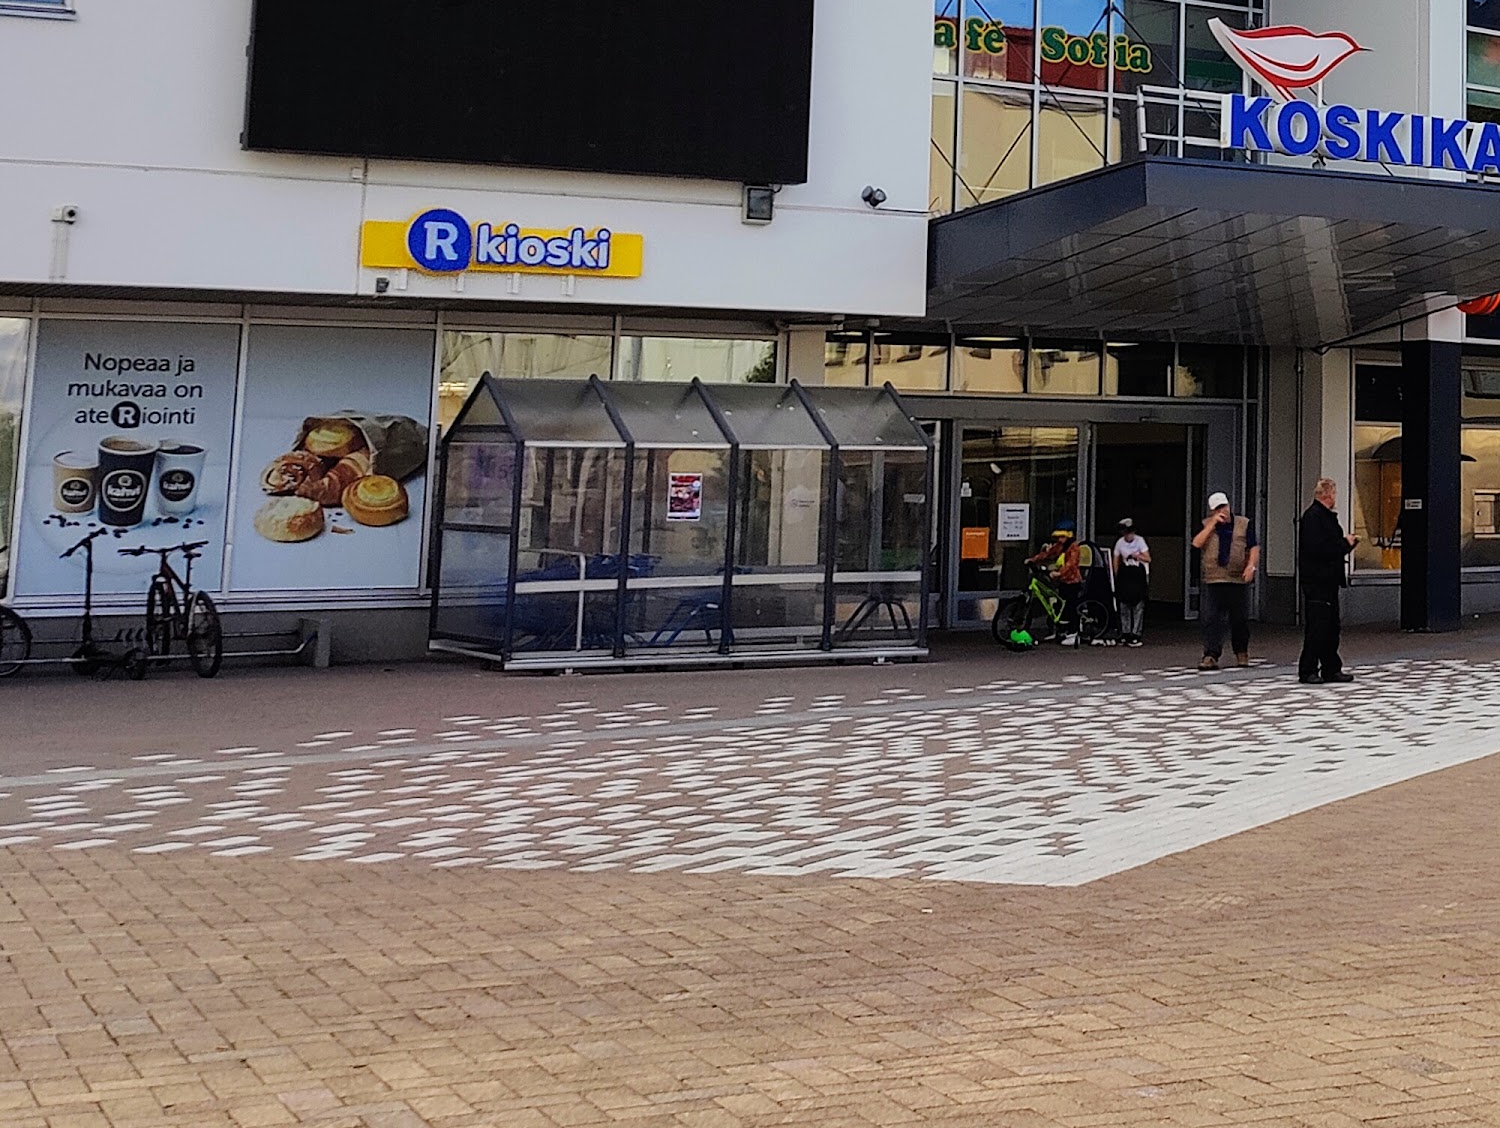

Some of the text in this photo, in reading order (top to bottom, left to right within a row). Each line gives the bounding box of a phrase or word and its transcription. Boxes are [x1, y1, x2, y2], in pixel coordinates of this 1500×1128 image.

[934, 16, 1153, 73] afé Sofia
[475, 223, 611, 269] kioski
[84, 353, 195, 377] Nopeaa ja
[67, 380, 203, 398] mukavaa on
